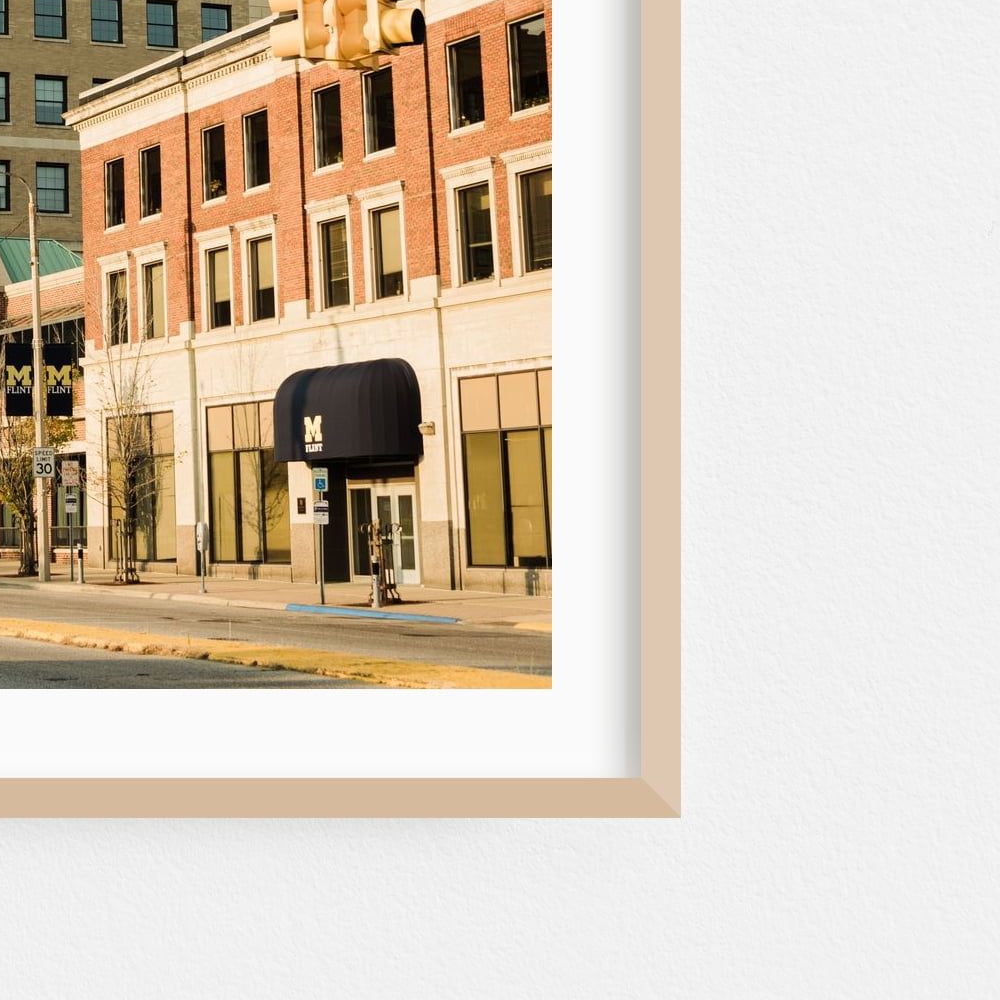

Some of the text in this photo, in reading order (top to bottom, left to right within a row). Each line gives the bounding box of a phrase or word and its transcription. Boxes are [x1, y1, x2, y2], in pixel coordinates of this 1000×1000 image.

[6, 365, 31, 385] M
[47, 365, 71, 385] M
[7, 386, 31, 394] FLINT
[48, 386, 71, 394] FLINT
[304, 415, 322, 443] M
[305, 443, 323, 453] FLINT
[36, 463, 52, 474] 30
